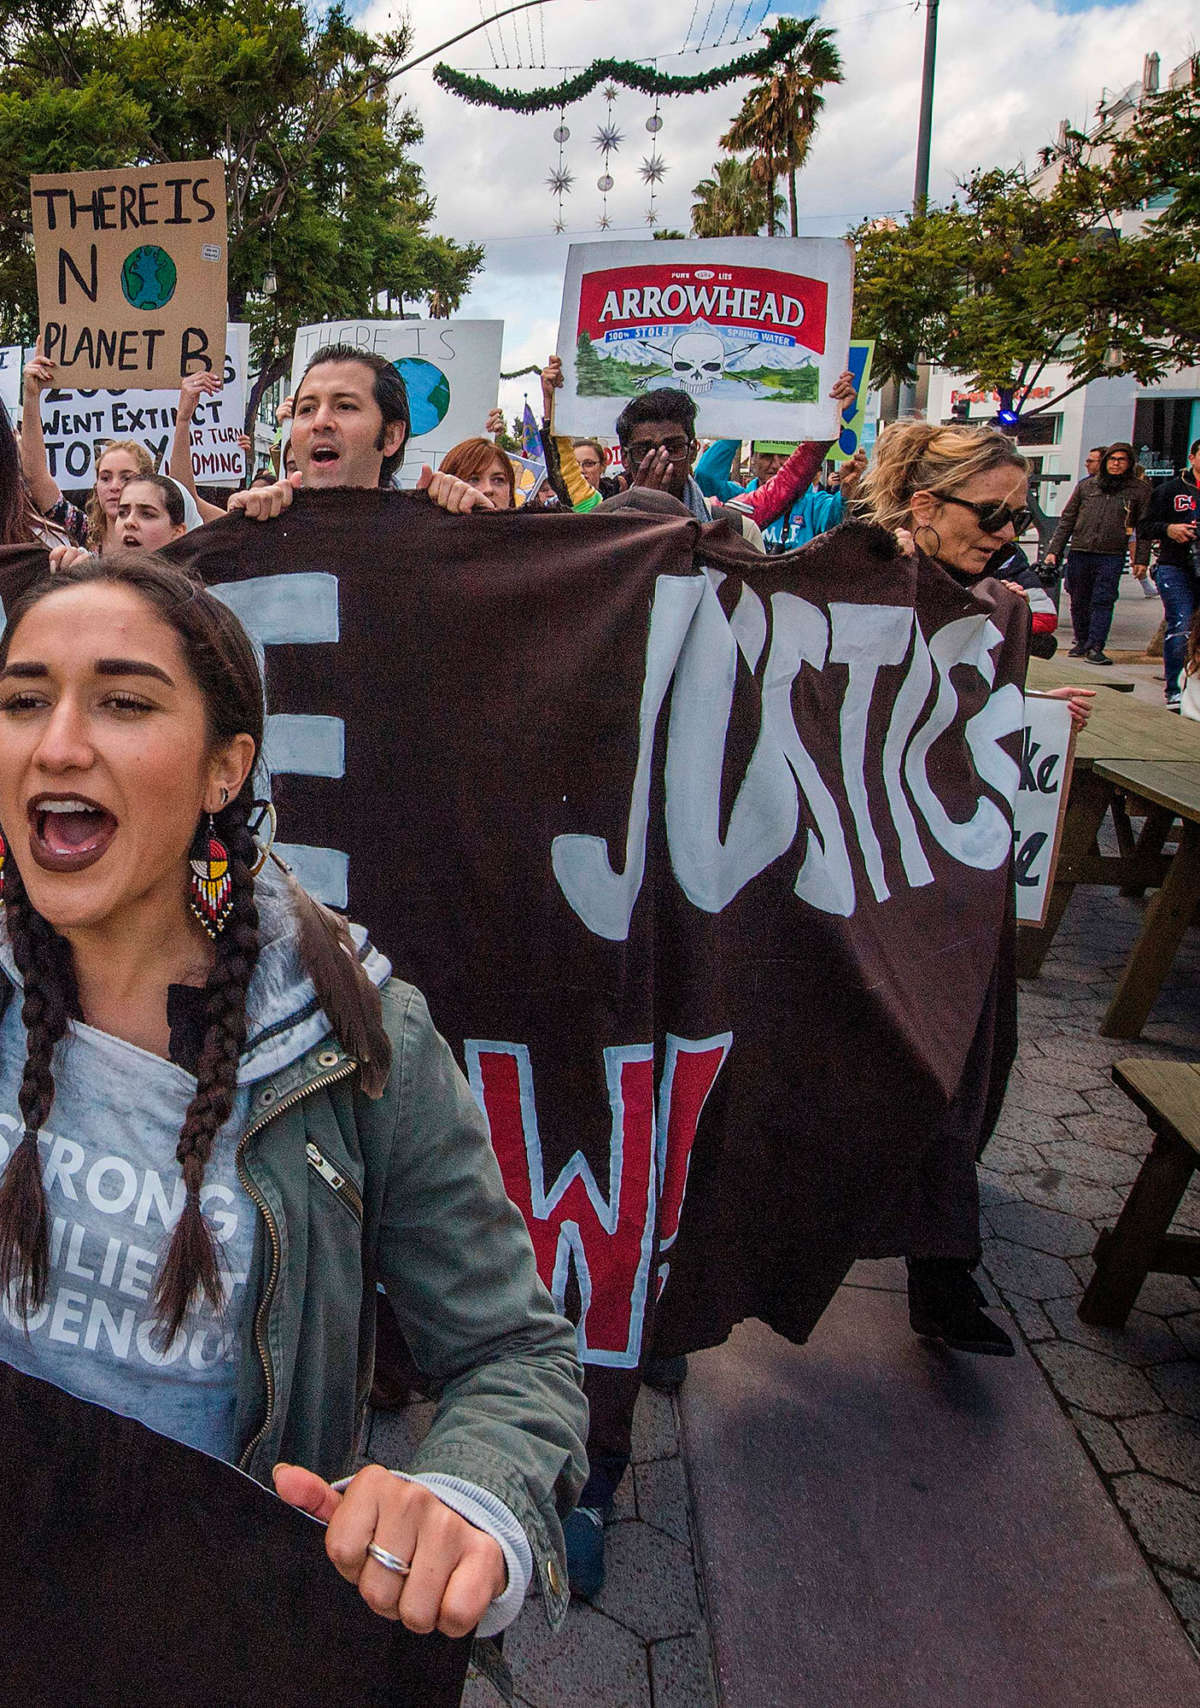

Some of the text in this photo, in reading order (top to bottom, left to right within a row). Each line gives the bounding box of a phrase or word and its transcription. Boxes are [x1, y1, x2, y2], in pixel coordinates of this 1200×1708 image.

[33, 178, 216, 230] THERE IS
[598, 284, 805, 327] ARROWHEAD
[44, 322, 164, 370] PLANET
[180, 327, 212, 377] B
[406, 328, 456, 360] IS
[761, 333, 790, 346] WATER
[40, 410, 104, 436] WENT
[44, 435, 169, 478] TOY
[191, 452, 242, 476] OMING
